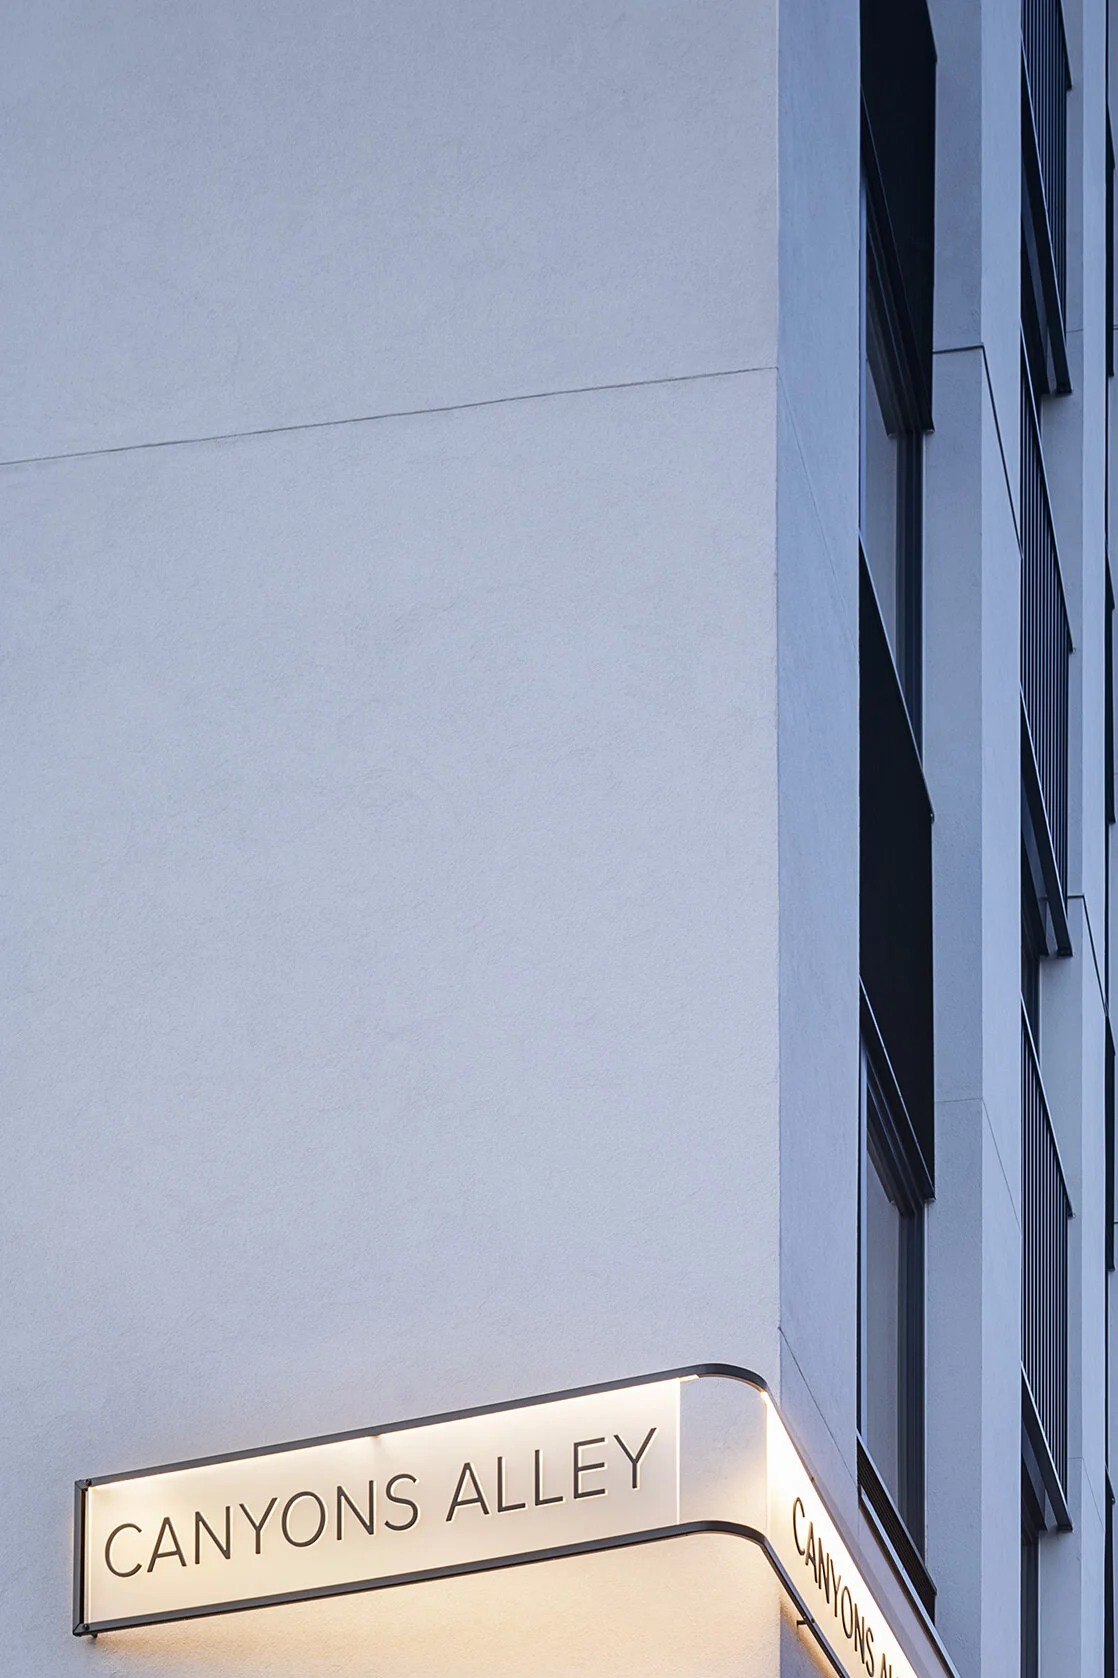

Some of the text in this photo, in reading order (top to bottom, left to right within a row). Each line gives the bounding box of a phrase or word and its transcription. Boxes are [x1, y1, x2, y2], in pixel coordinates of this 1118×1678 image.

[104, 1427, 657, 1578] CANYONS ALLEY
[793, 1497, 875, 1678] CANYONS
